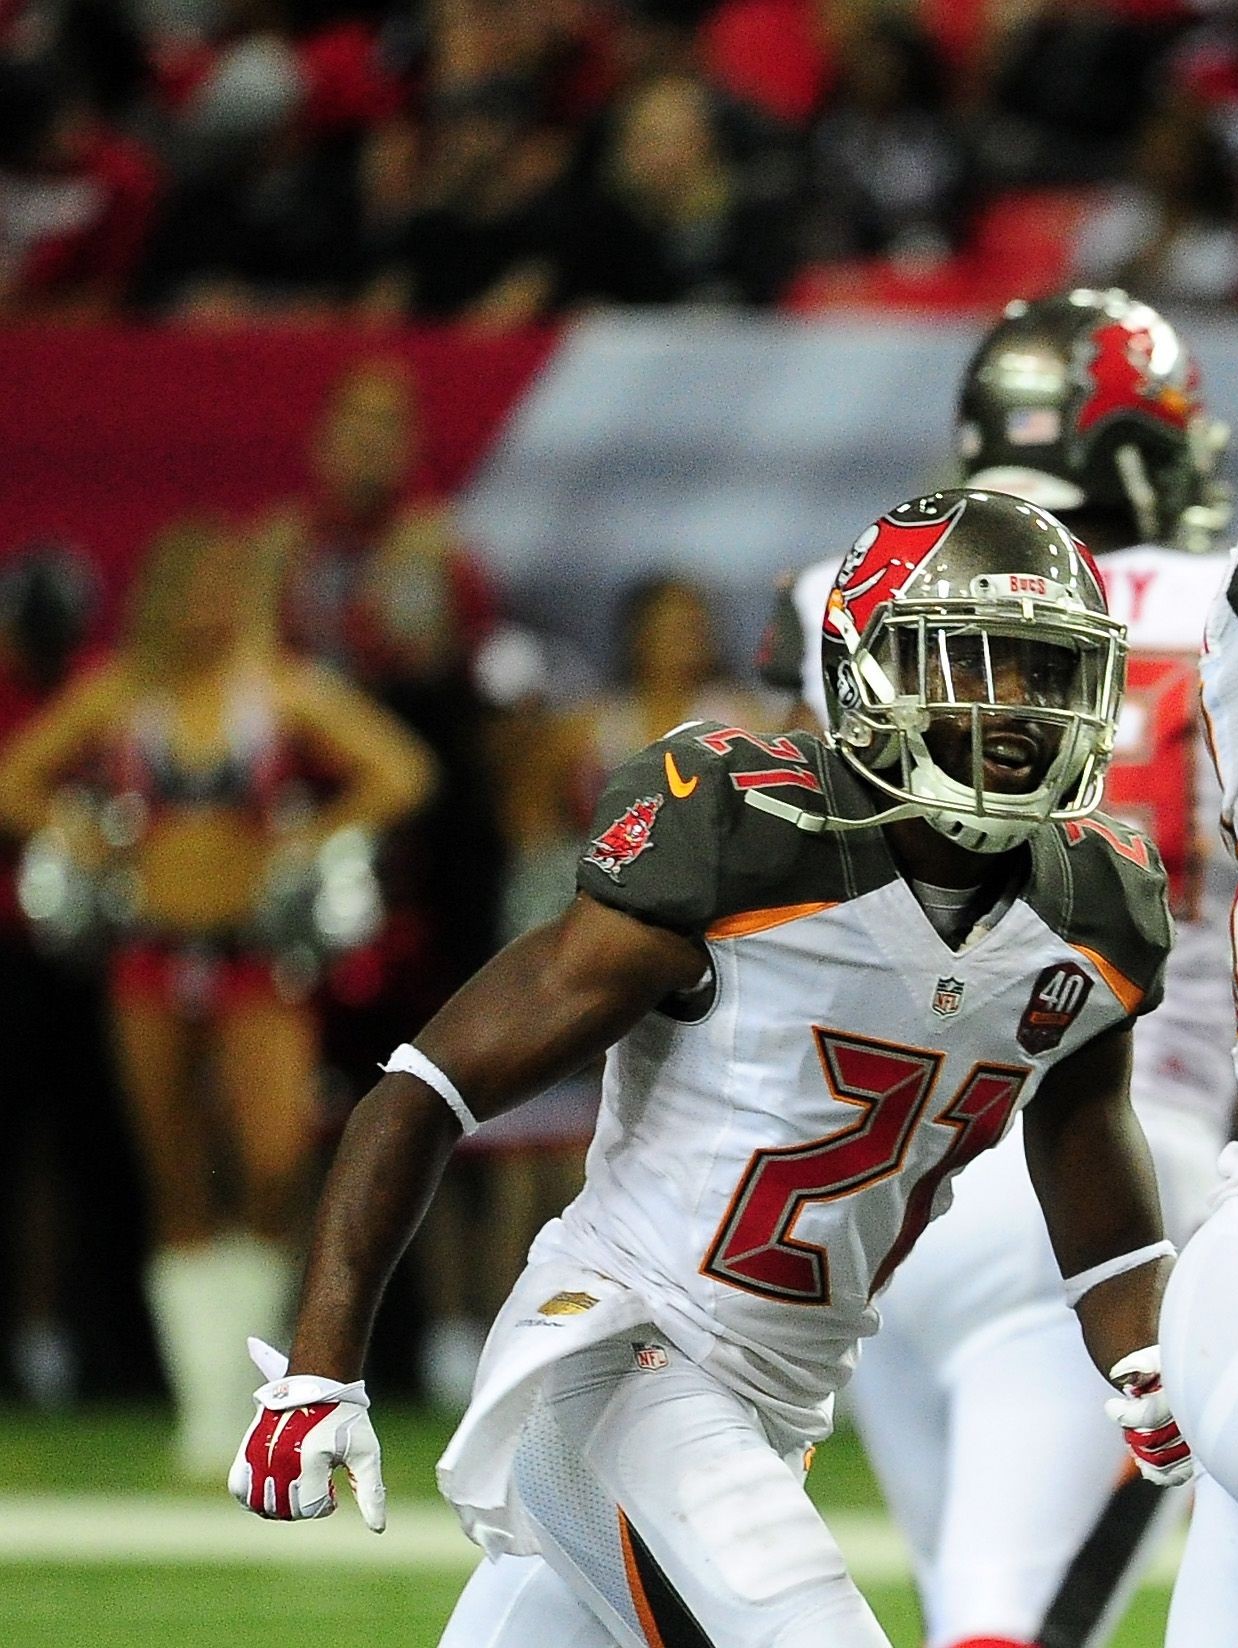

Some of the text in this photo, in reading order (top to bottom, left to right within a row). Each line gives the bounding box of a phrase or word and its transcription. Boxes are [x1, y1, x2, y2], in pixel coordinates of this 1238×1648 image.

[1009, 576, 1046, 595] BUCS
[1039, 970, 1085, 1013] 40
[699, 1024, 1032, 1307] 21
